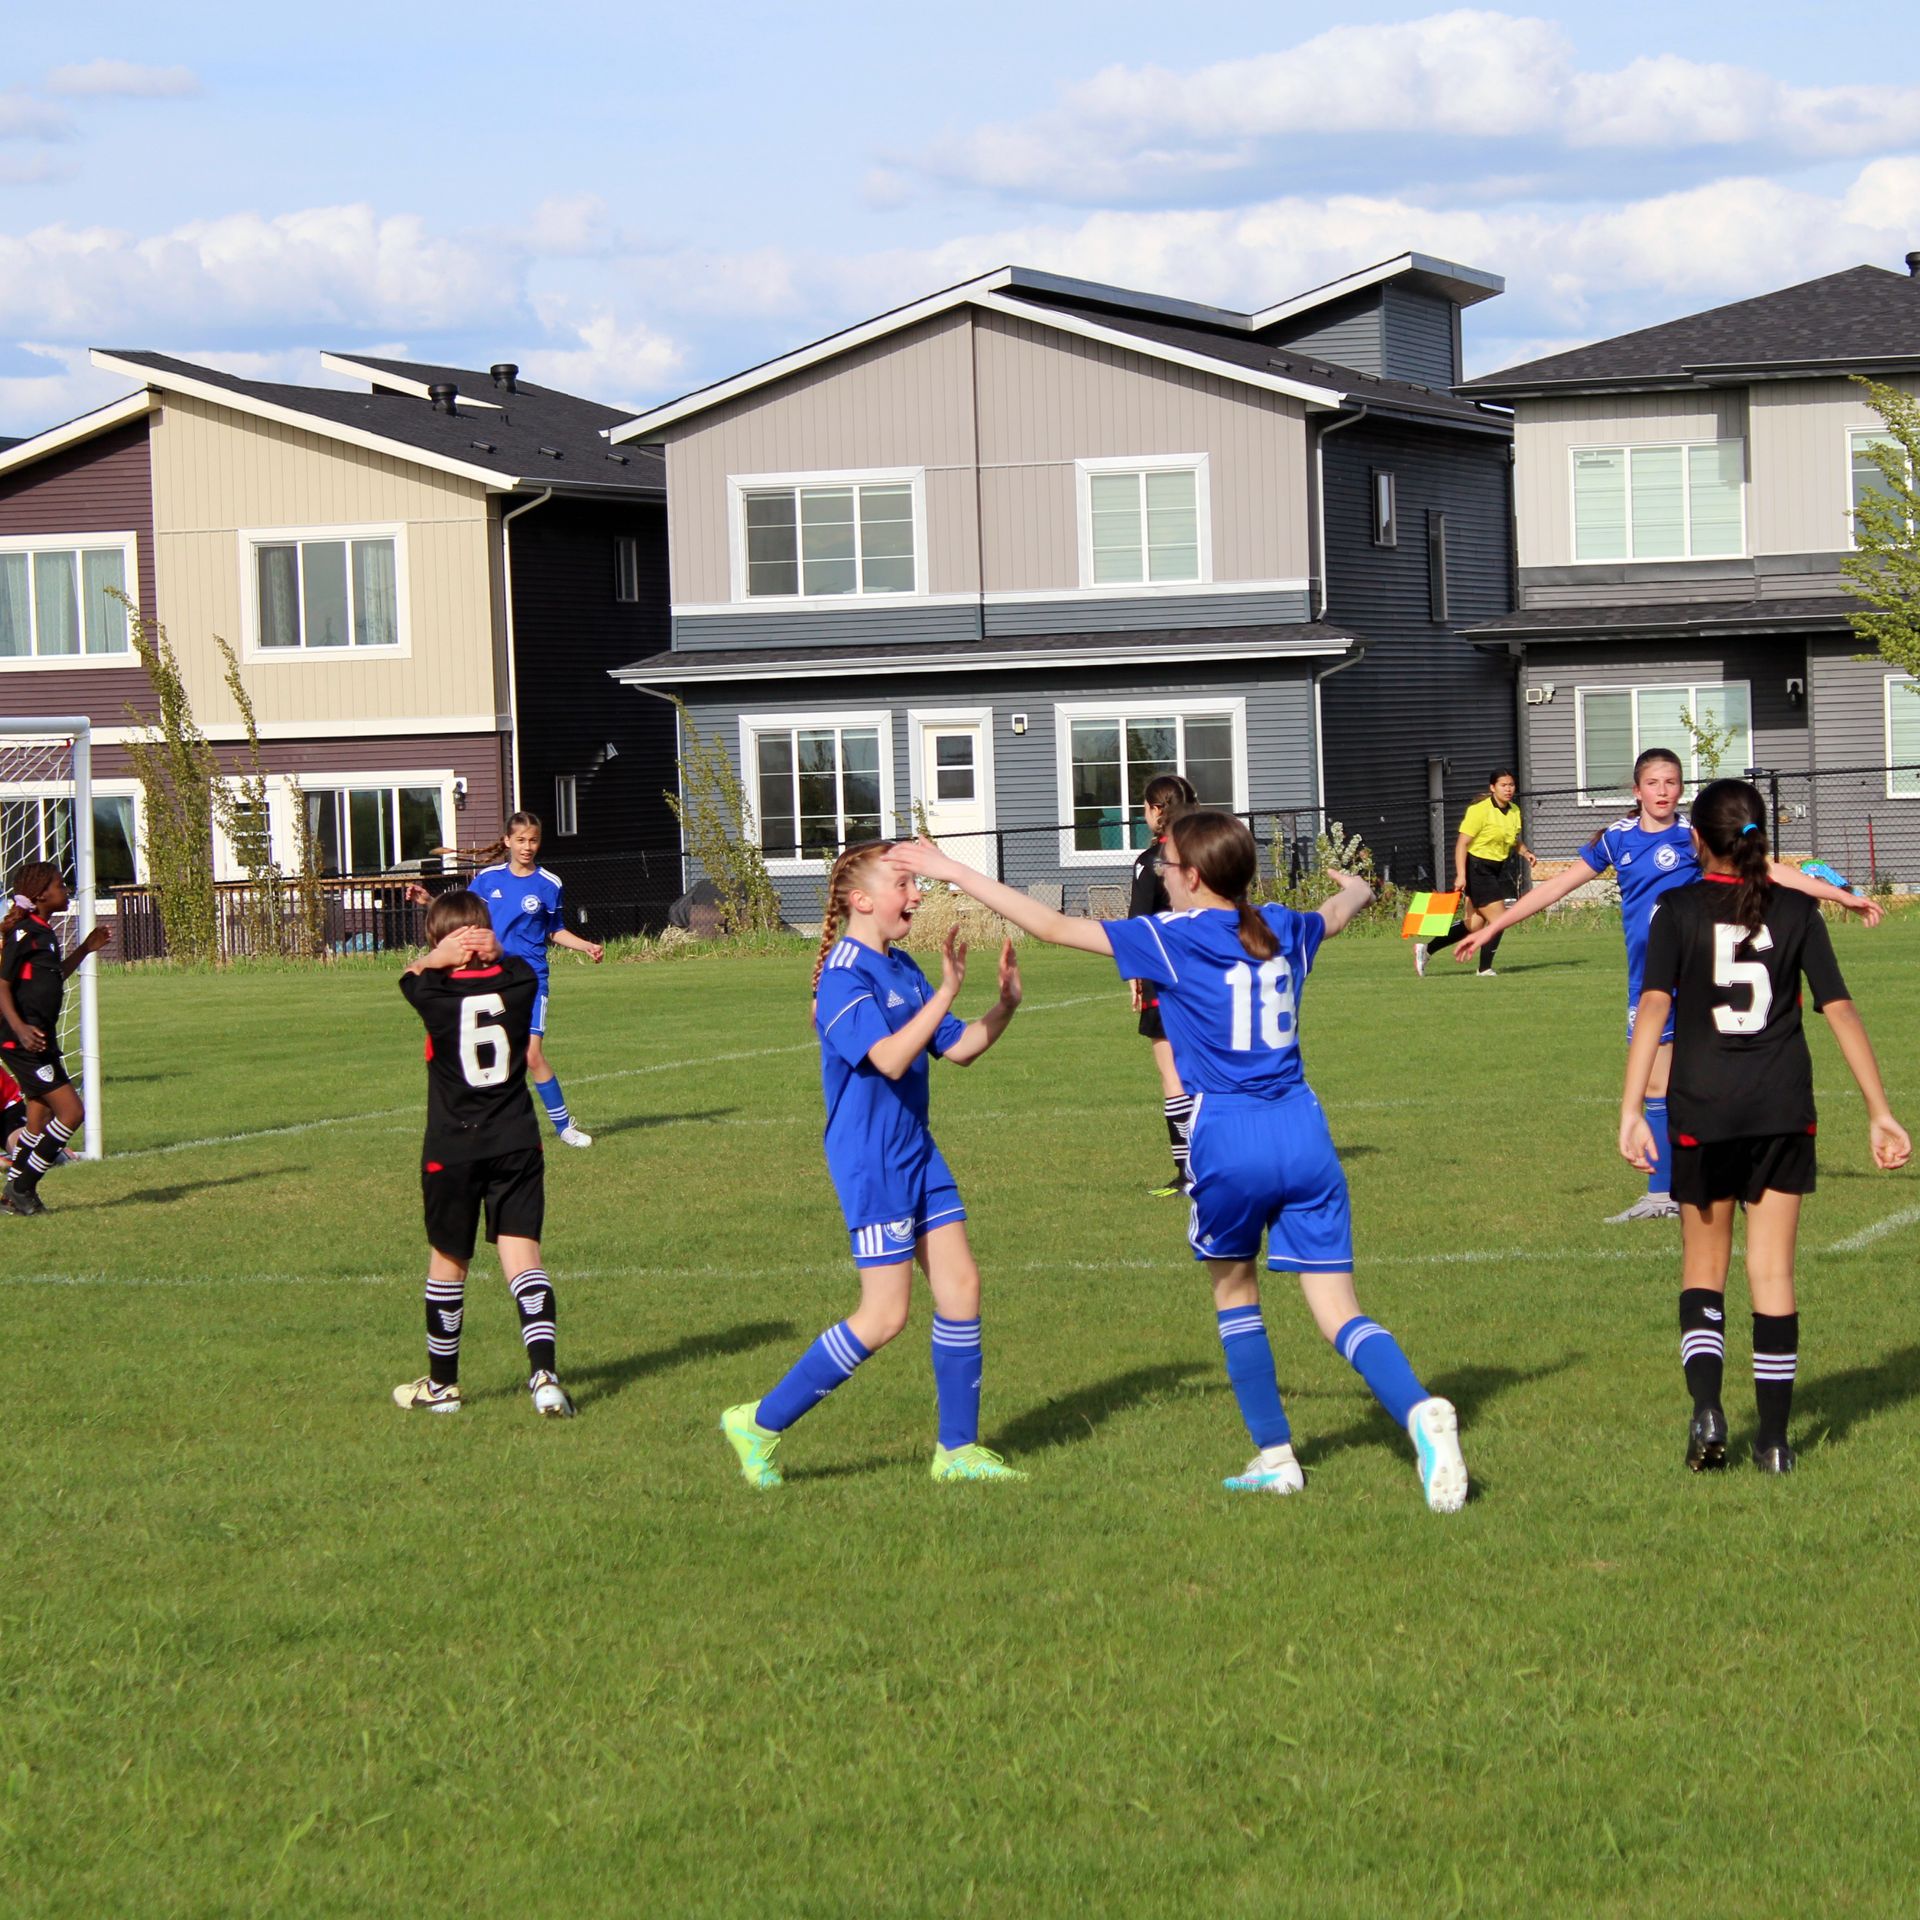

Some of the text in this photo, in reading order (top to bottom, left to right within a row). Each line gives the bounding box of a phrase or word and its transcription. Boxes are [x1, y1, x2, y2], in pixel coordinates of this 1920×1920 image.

[1225, 956, 1297, 1051] 18
[1712, 923, 1774, 1034] 5
[460, 993, 511, 1088] 6
